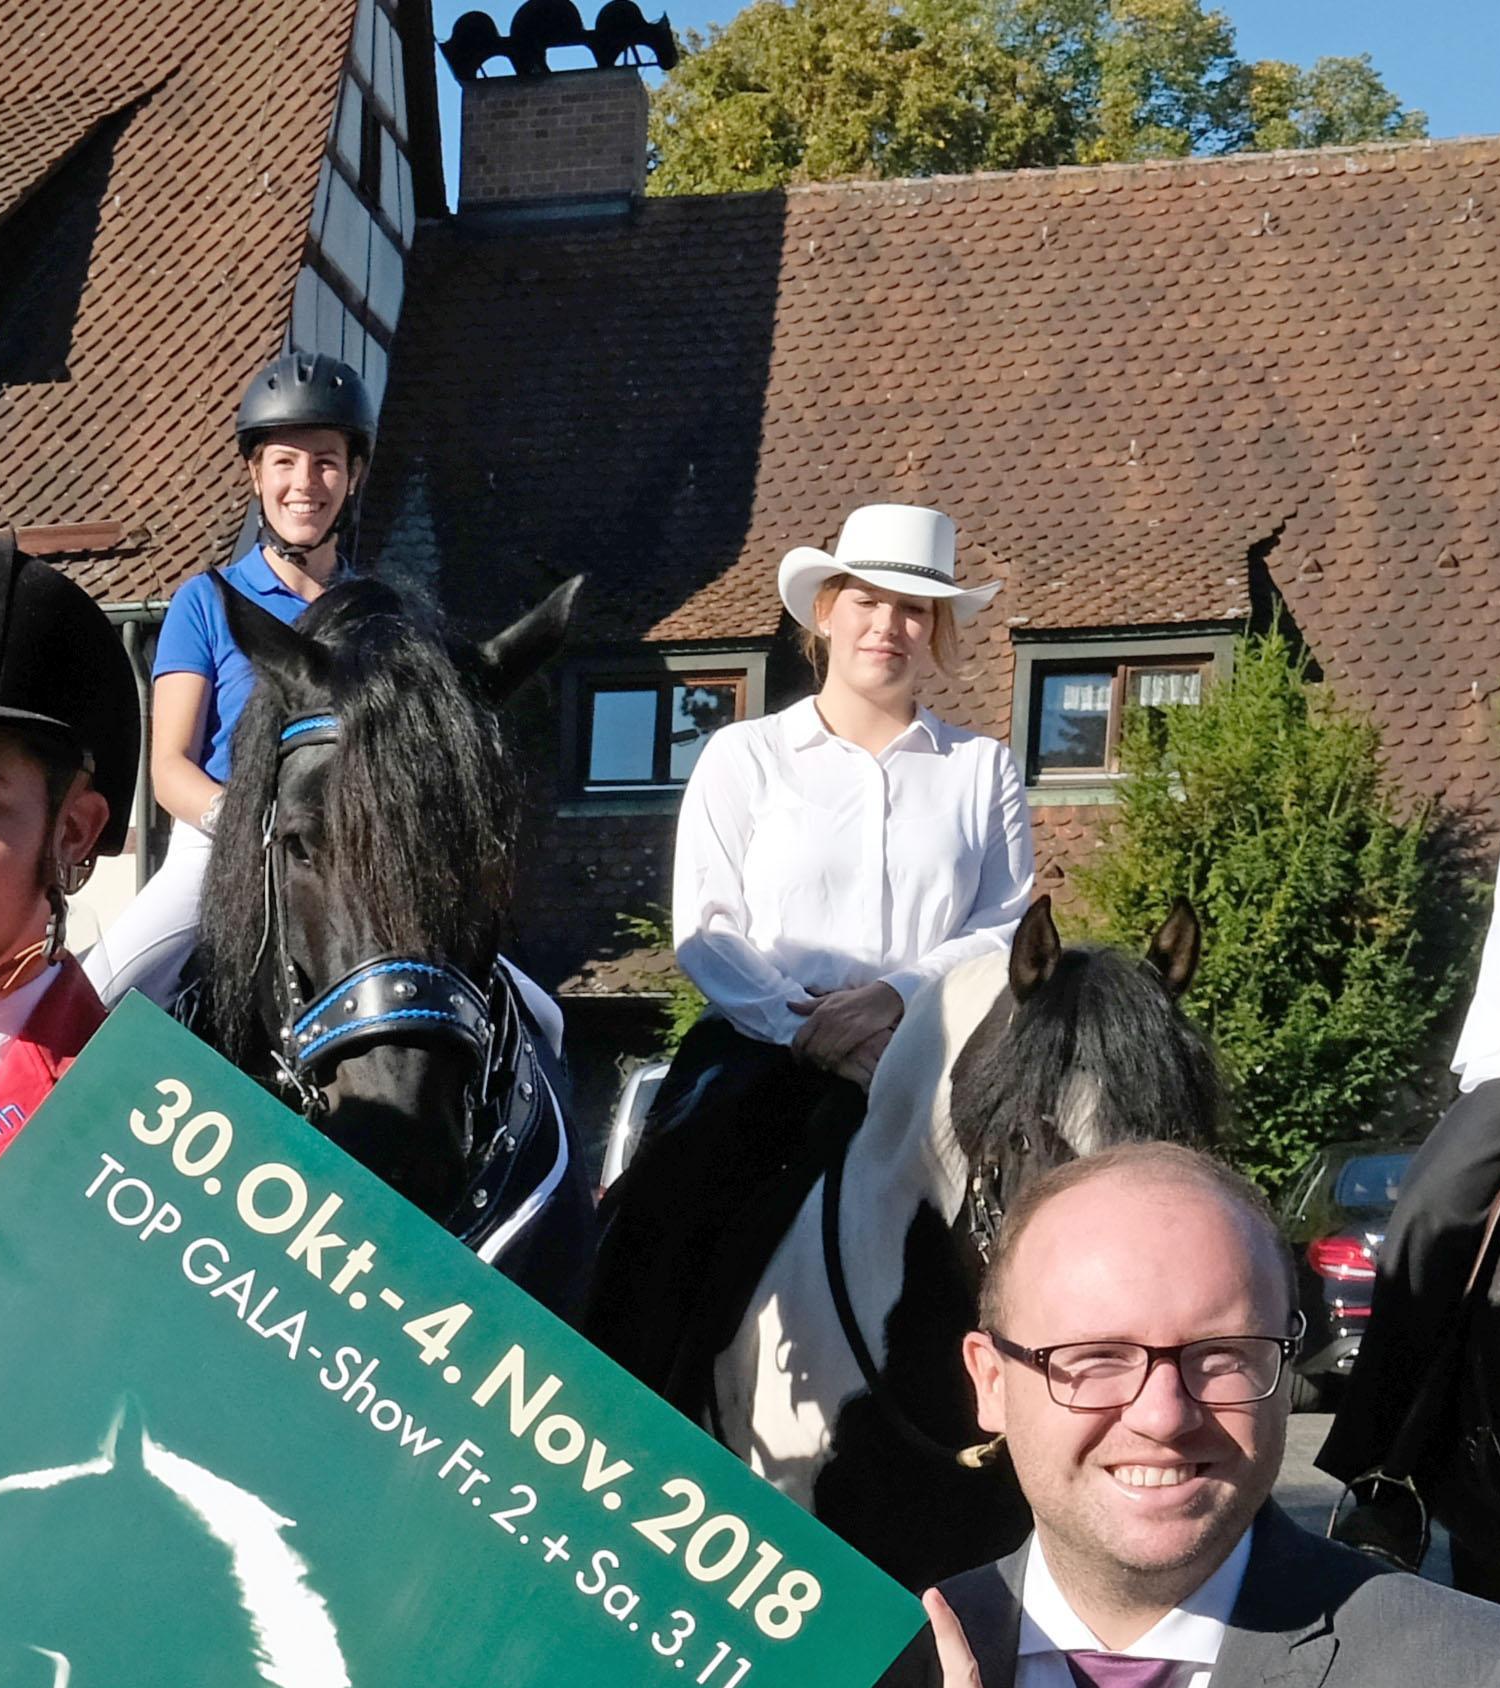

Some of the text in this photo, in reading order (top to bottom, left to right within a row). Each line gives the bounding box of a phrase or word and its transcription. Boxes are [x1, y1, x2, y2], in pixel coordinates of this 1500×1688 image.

[85, 1153, 181, 1241] TOP
[182, 1238, 442, 1456] GALA-Show
[438, 1439, 490, 1506] Fr.
[490, 1485, 537, 1544] 2.
[543, 1535, 570, 1562] +
[576, 1550, 640, 1631] Sa.
[472, 1344, 633, 1510] Nov.
[632, 1479, 821, 1639] 2018
